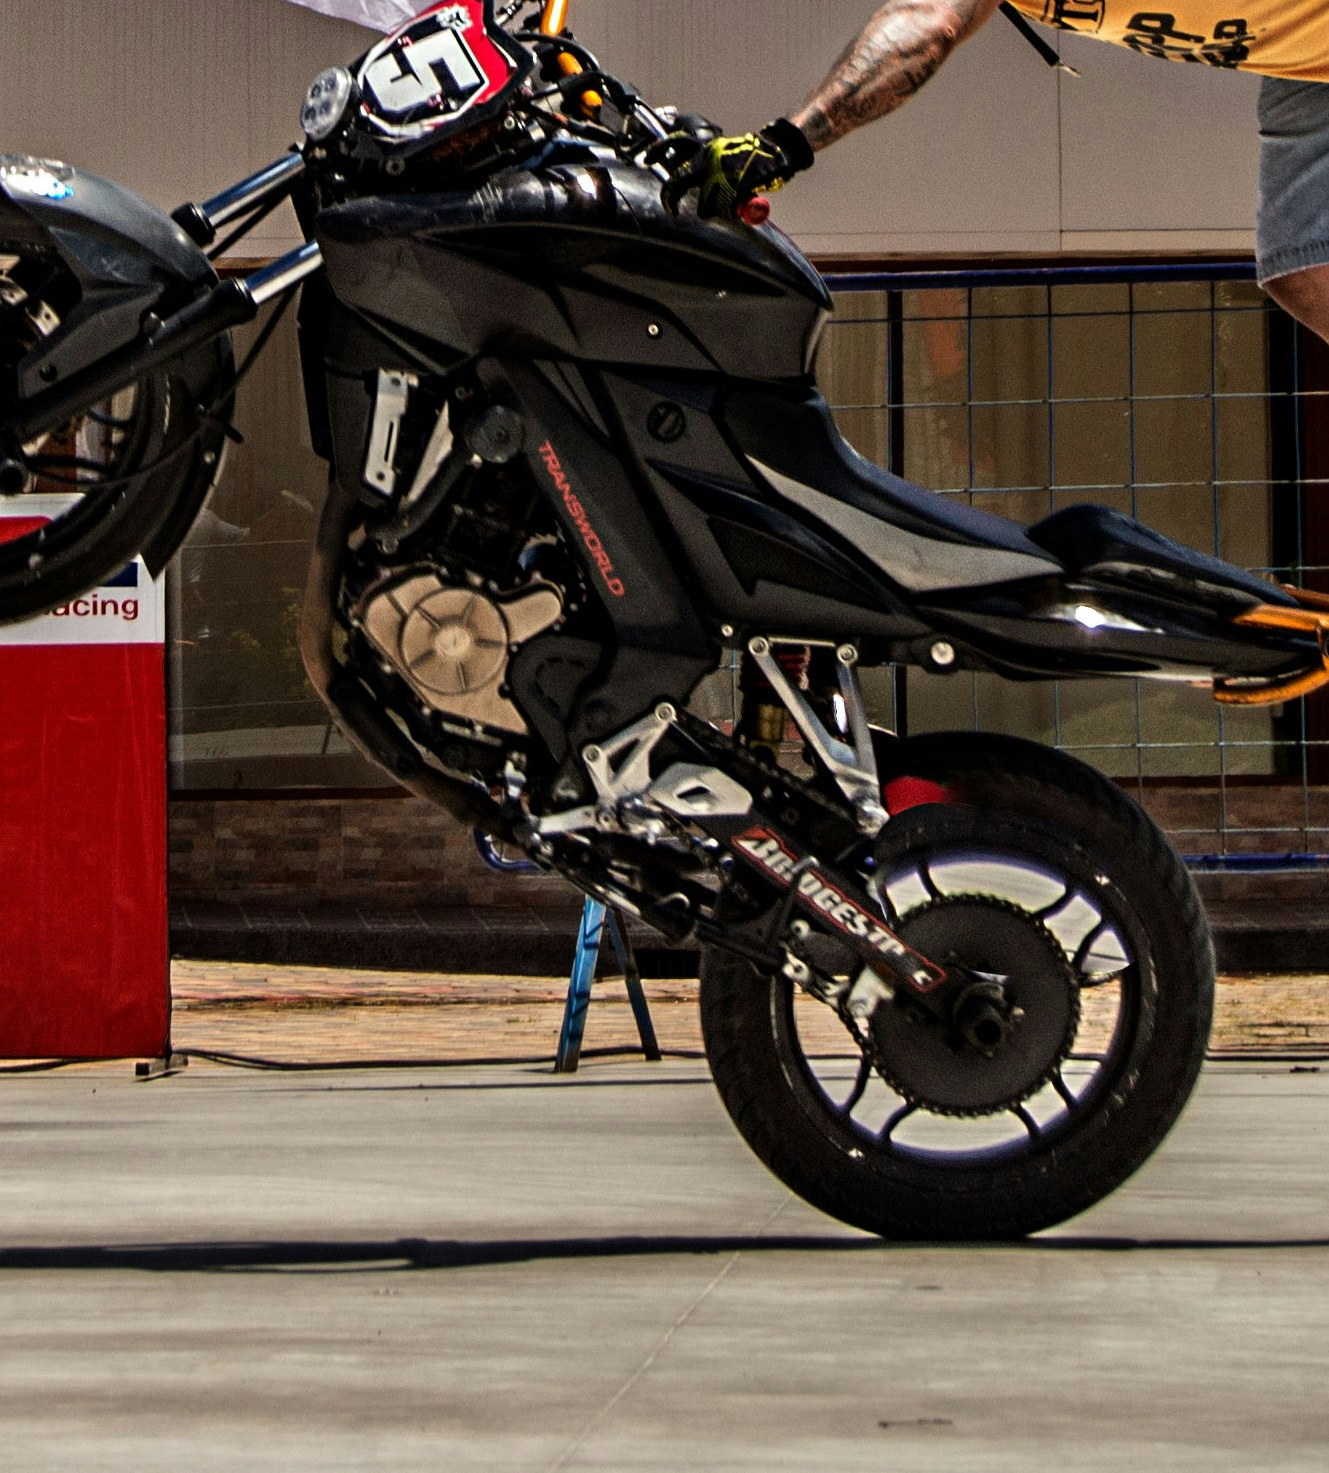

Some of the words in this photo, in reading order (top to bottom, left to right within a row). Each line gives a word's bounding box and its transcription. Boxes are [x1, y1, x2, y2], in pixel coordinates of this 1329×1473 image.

[363, 27, 489, 115] 5
[537, 439, 626, 598] TRANSWORLD
[51, 594, 139, 621] acing
